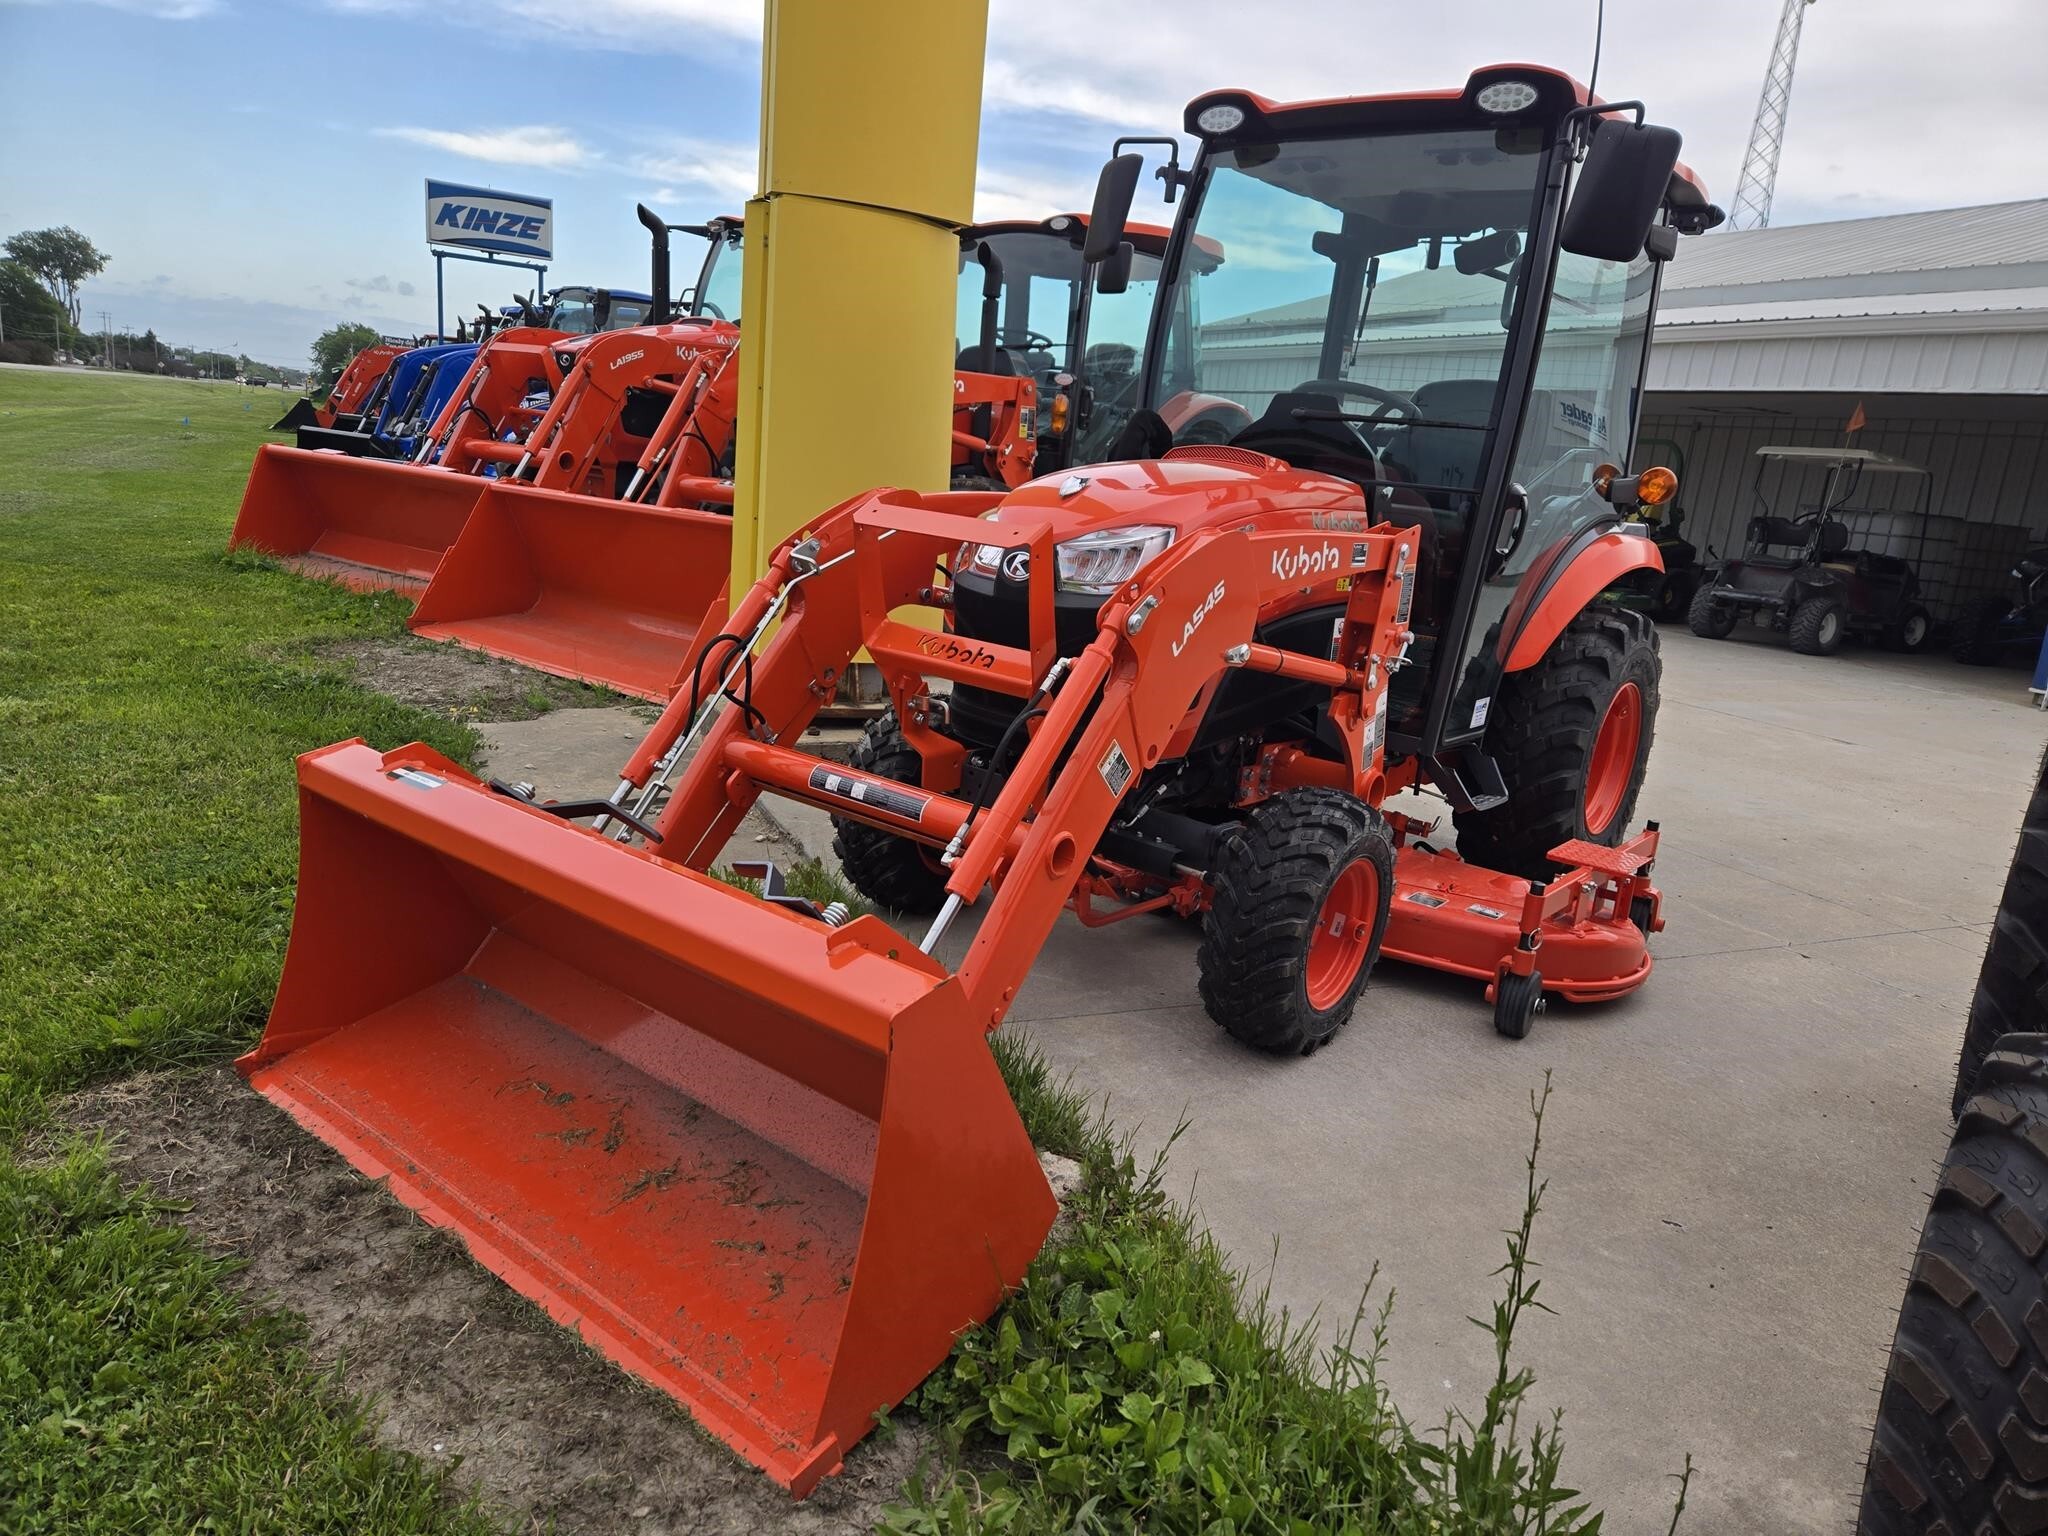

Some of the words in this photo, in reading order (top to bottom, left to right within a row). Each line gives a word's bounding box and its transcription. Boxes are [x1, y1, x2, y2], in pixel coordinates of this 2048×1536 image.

[435, 203, 546, 240] KINZE
[610, 350, 645, 370] LA1955
[1272, 541, 1340, 580] Kubota
[1171, 579, 1225, 657] LA545
[916, 634, 996, 669] Kubota
